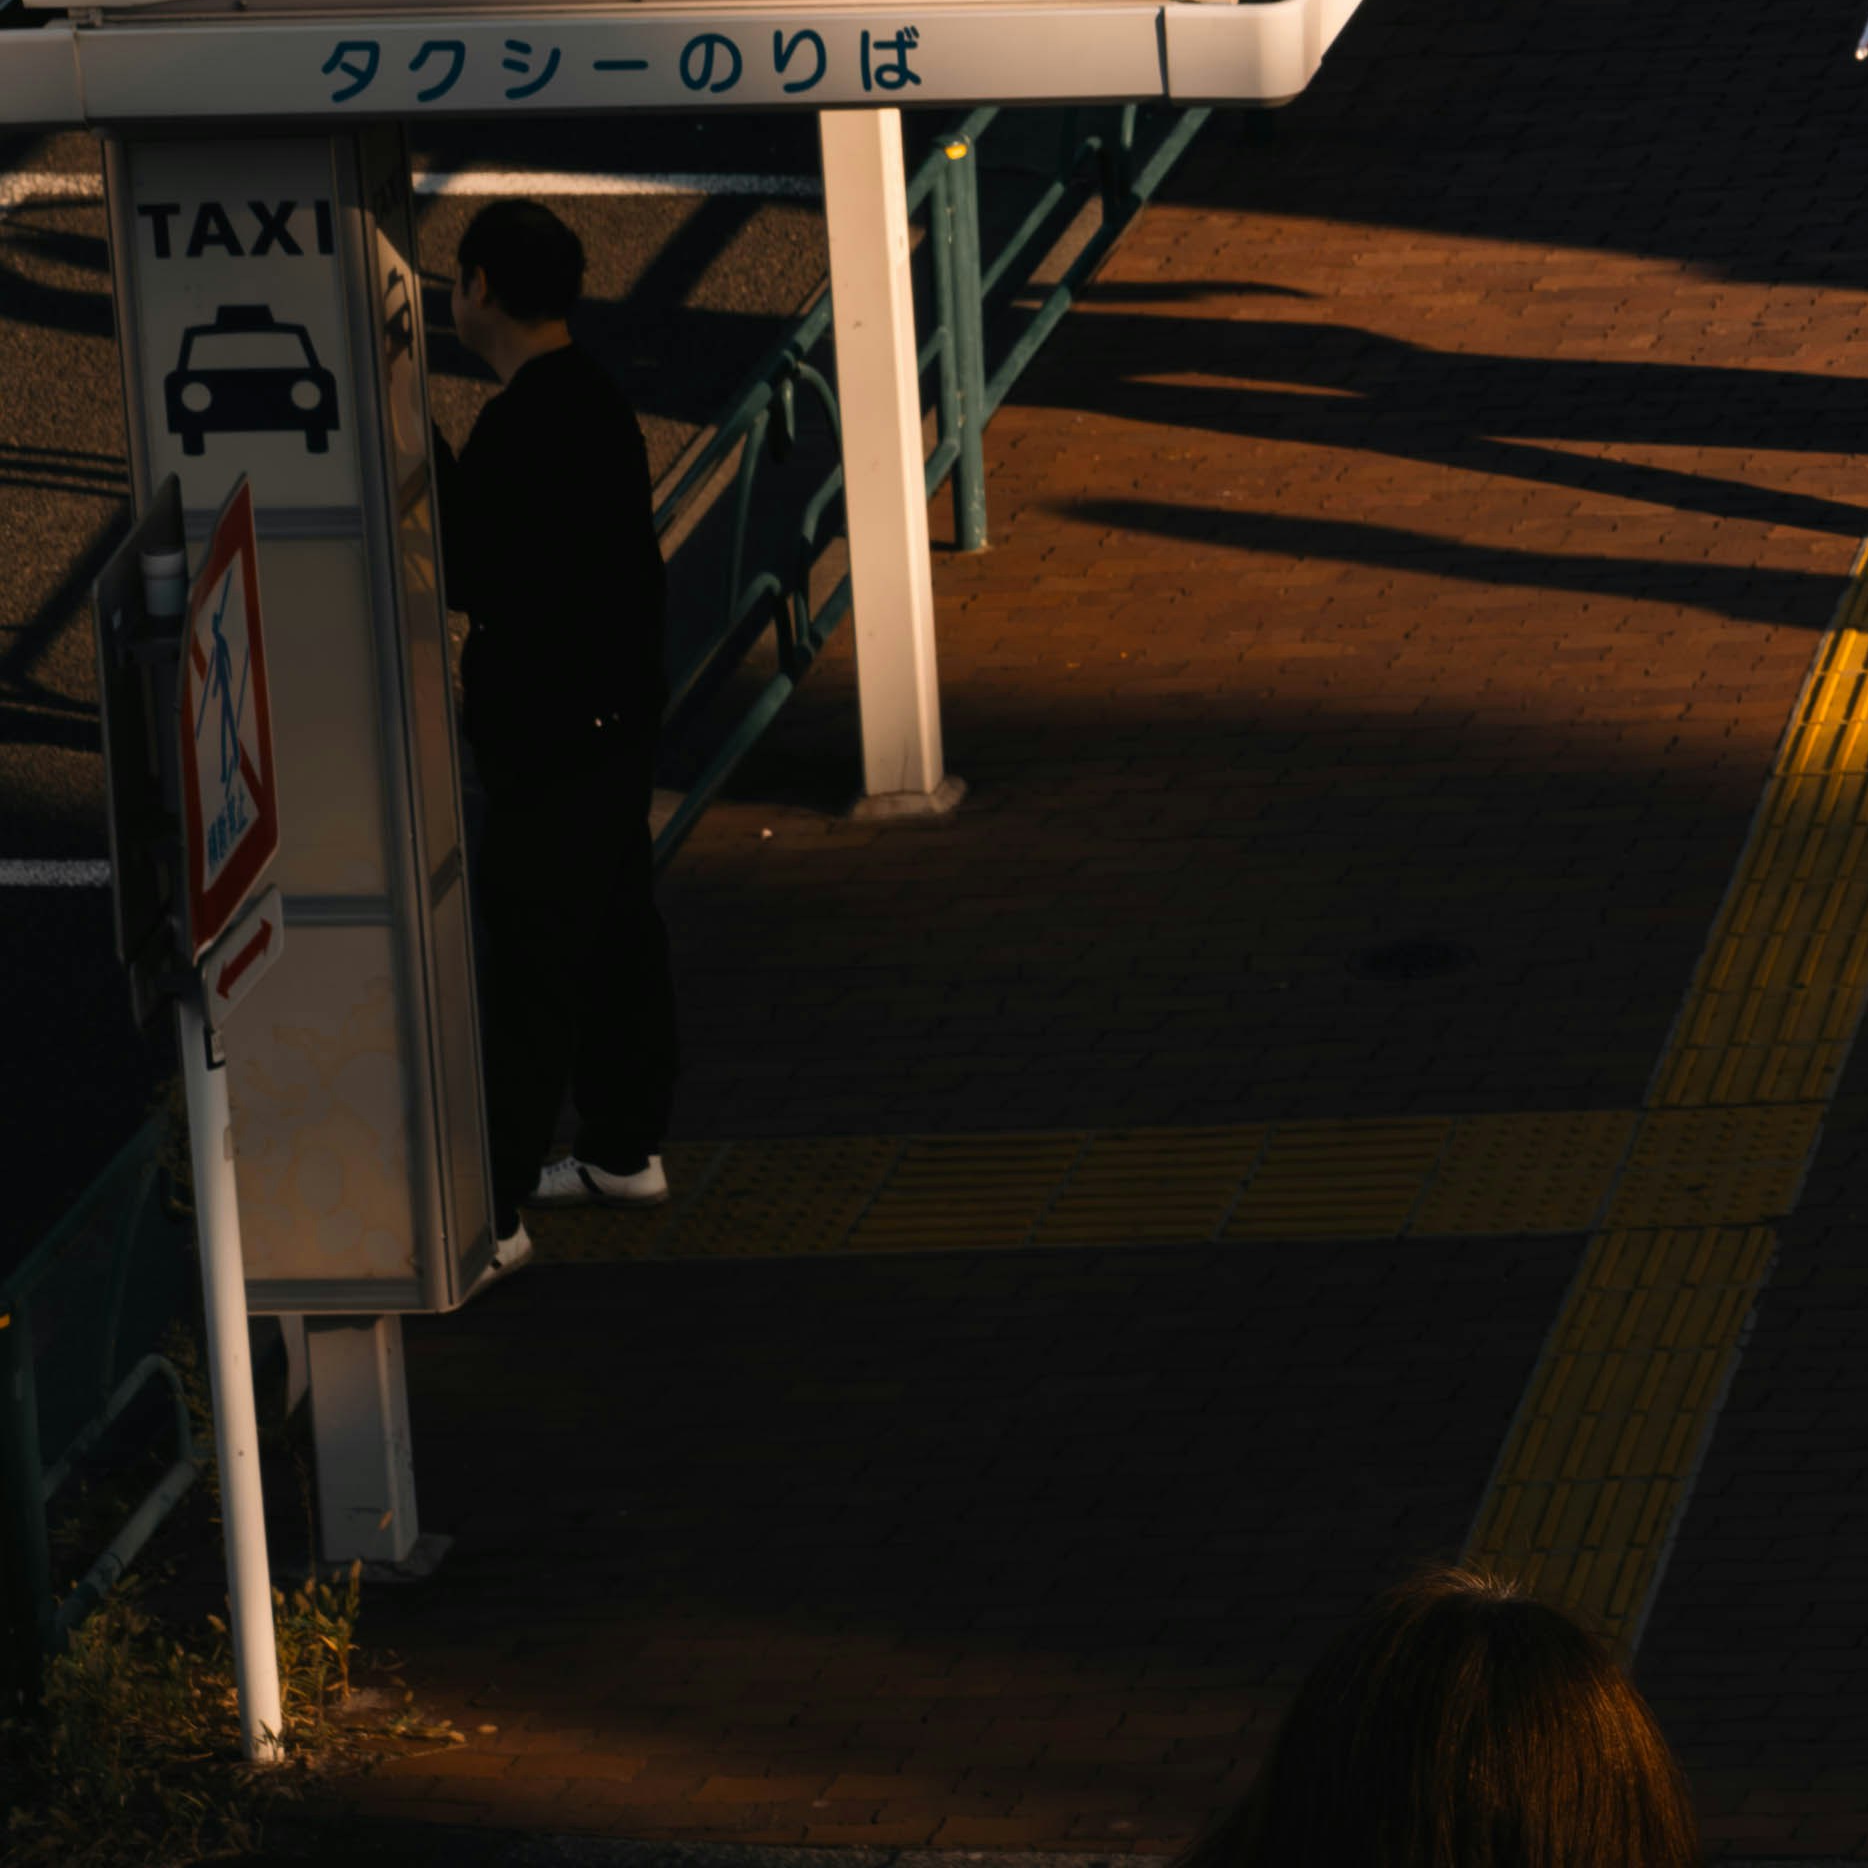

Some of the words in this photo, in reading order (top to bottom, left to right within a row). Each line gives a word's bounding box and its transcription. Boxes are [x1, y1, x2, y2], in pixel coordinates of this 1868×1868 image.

[322, 29, 921, 102] タクシーのりば
[138, 200, 333, 257] TAXI
